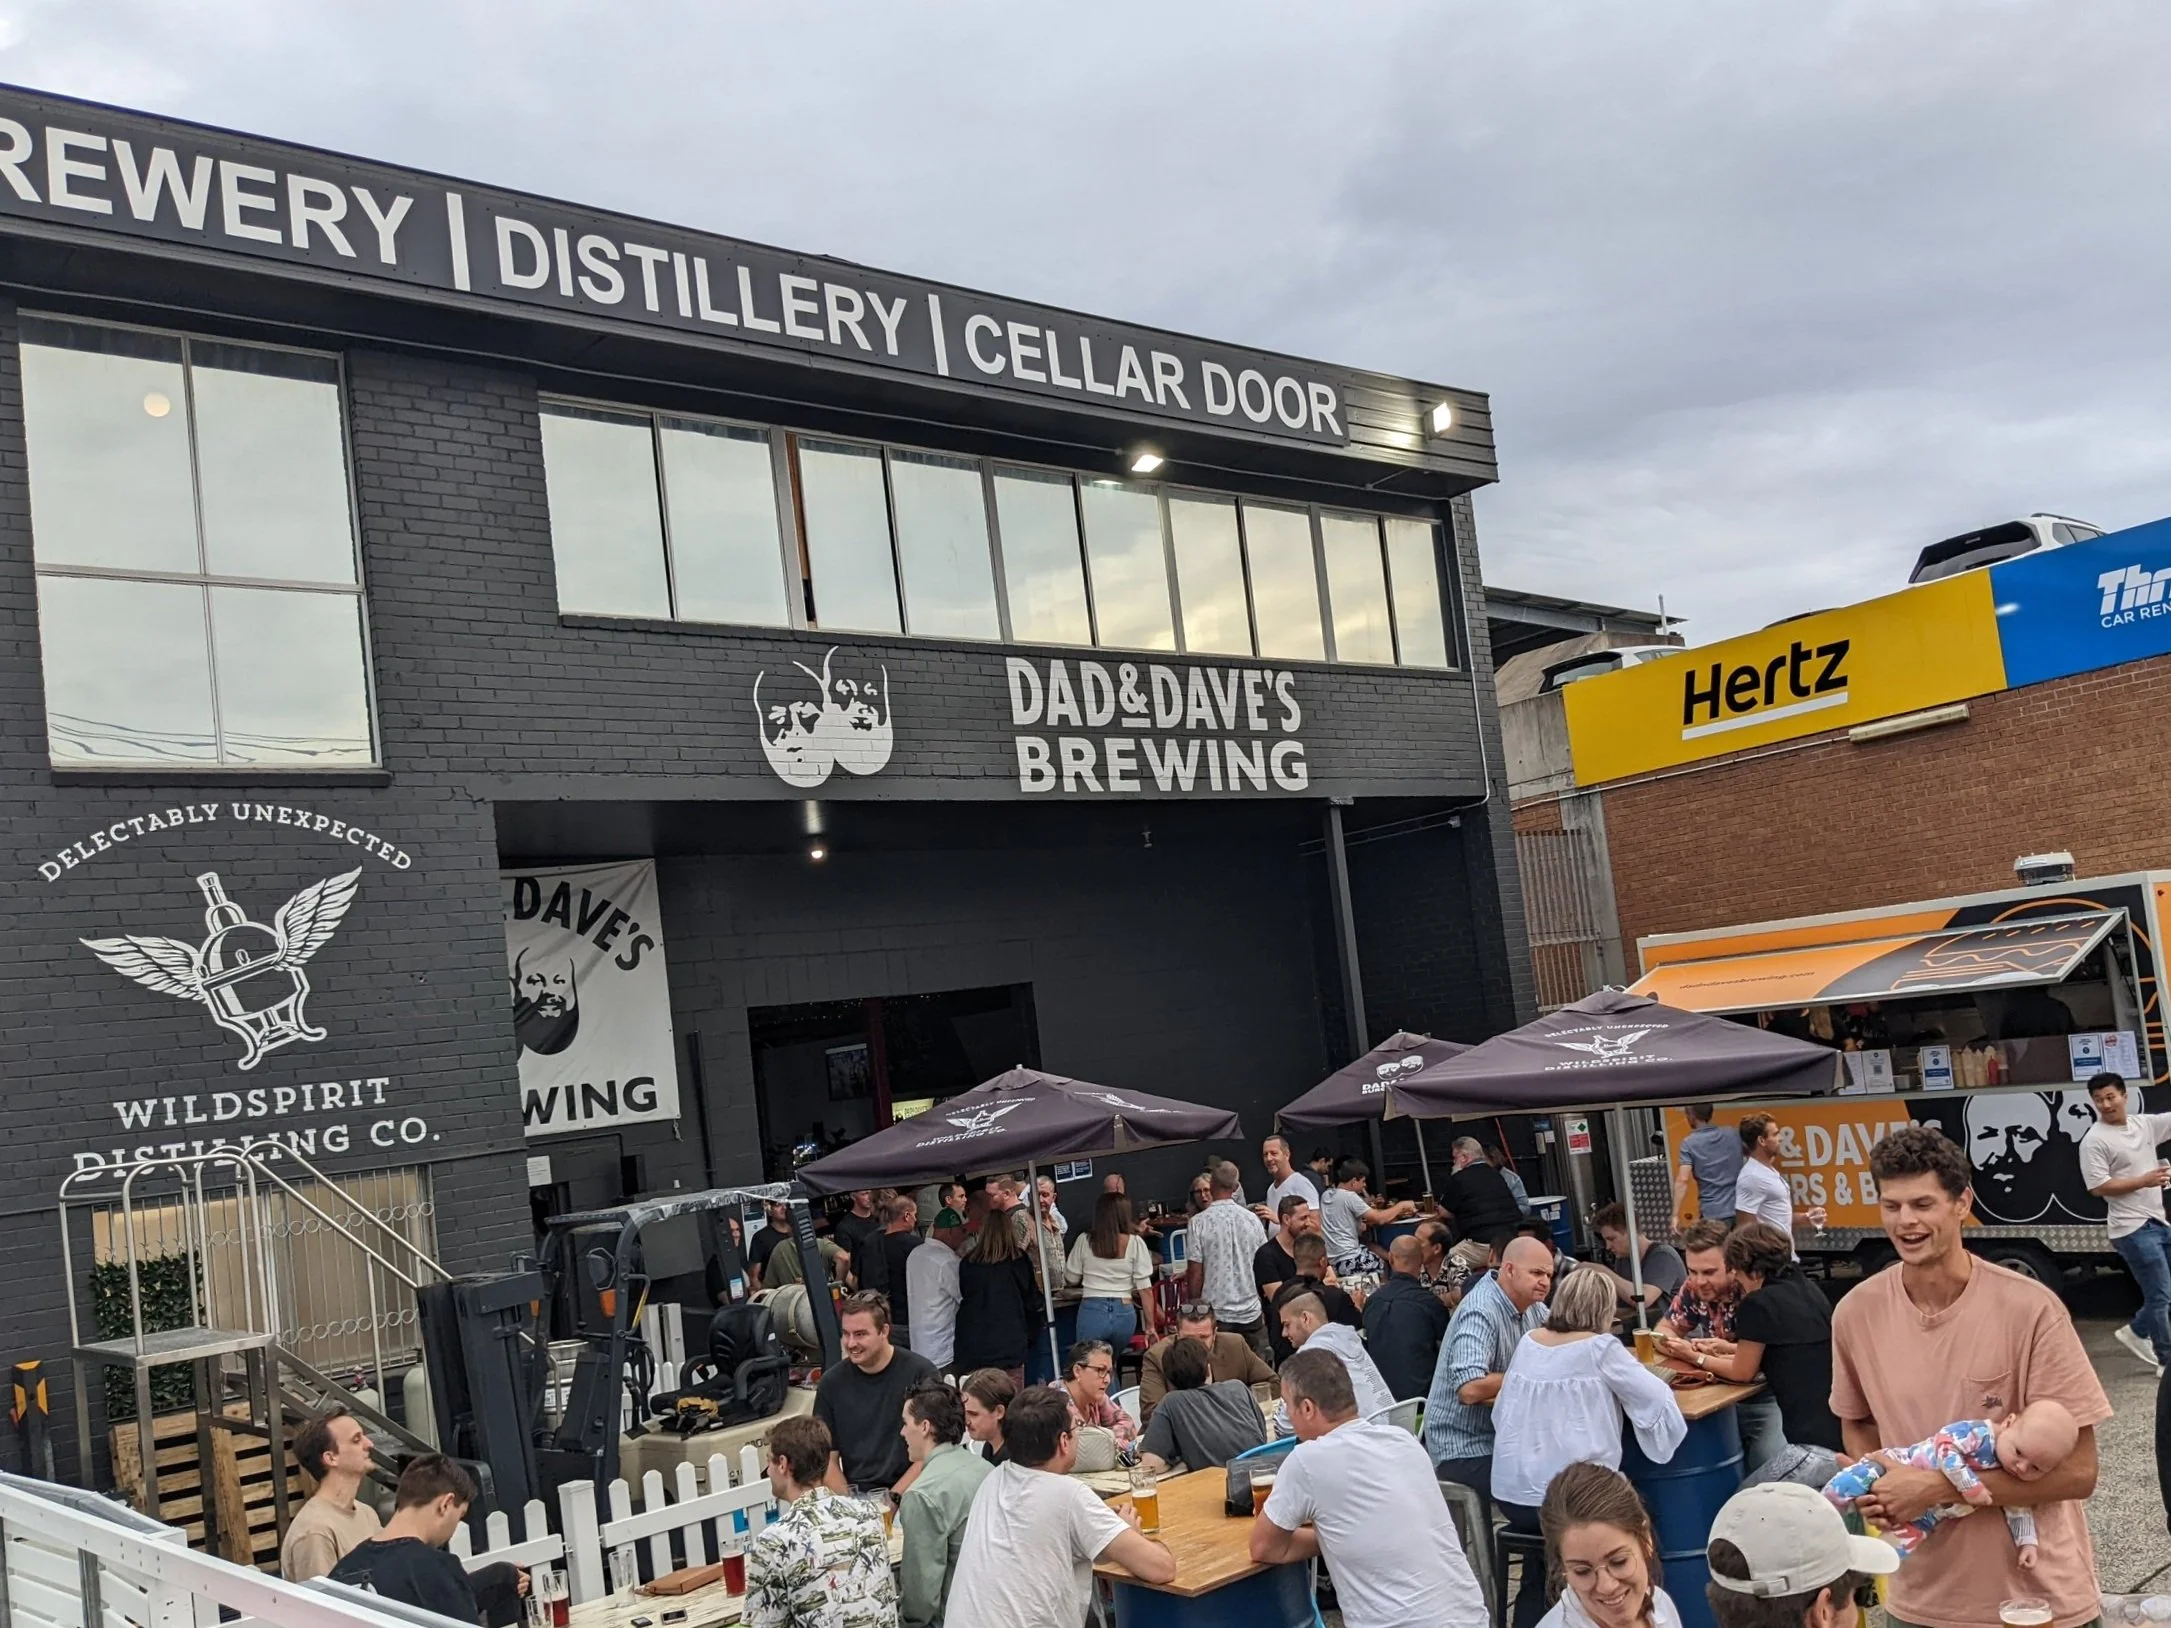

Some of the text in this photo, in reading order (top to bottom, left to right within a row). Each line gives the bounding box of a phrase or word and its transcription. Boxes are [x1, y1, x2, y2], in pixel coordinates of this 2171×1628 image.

[495, 216, 907, 355] DISTILLERY
[965, 315, 1191, 410] CELLAR
[1202, 361, 1344, 436] DOOR
[2101, 611, 2135, 628] CAR
[1684, 639, 1850, 726] Hertz
[1016, 736, 1308, 793] BREWING
[38, 803, 412, 883] DELECTABLY UNEXPECTED
[513, 877, 654, 971] DAVE'S
[113, 1078, 390, 1130] WILDSPIRIT
[73, 1117, 440, 1182] DISTILLING CO.
